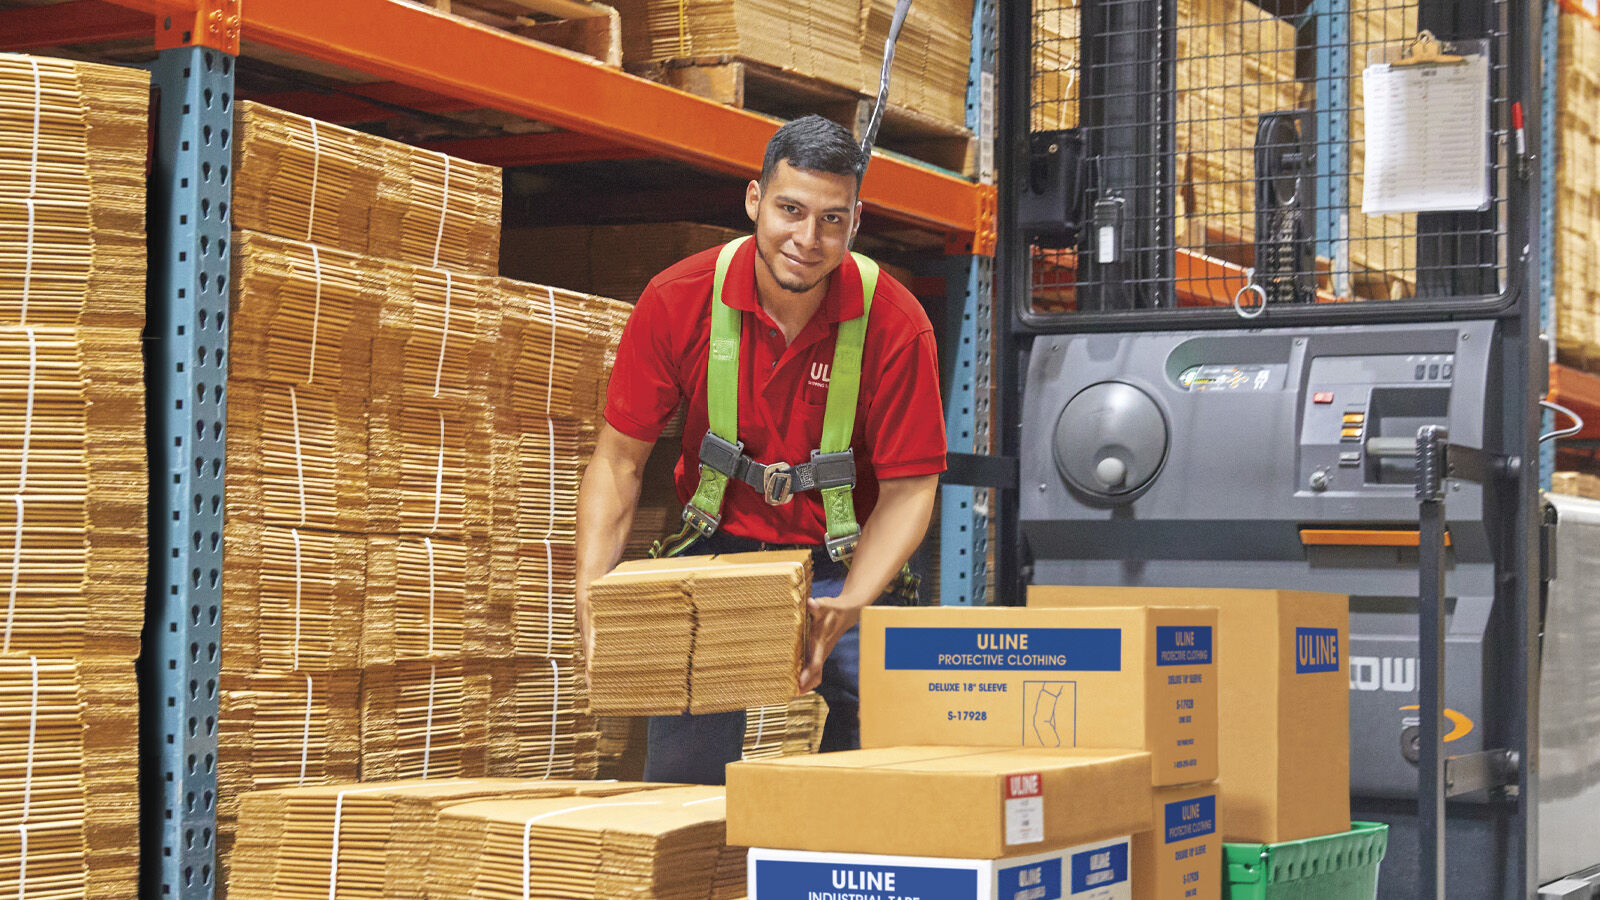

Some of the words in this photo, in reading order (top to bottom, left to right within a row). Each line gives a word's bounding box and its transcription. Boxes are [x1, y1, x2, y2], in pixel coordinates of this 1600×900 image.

[977, 634, 1029, 650] ULINE
[1175, 631, 1194, 646] ULINE
[1298, 634, 1338, 667] ULINE
[938, 654, 1004, 666] PROTECTIVE
[1007, 654, 1068, 666] CLOTHING
[928, 682, 960, 693] DELUXE
[963, 682, 977, 693] 18"
[978, 682, 1008, 693] SLEEVE
[947, 710, 988, 721] S-17928
[1010, 775, 1039, 797] ULINE
[1182, 803, 1200, 820] ULINE
[832, 869, 896, 892] ULINE
